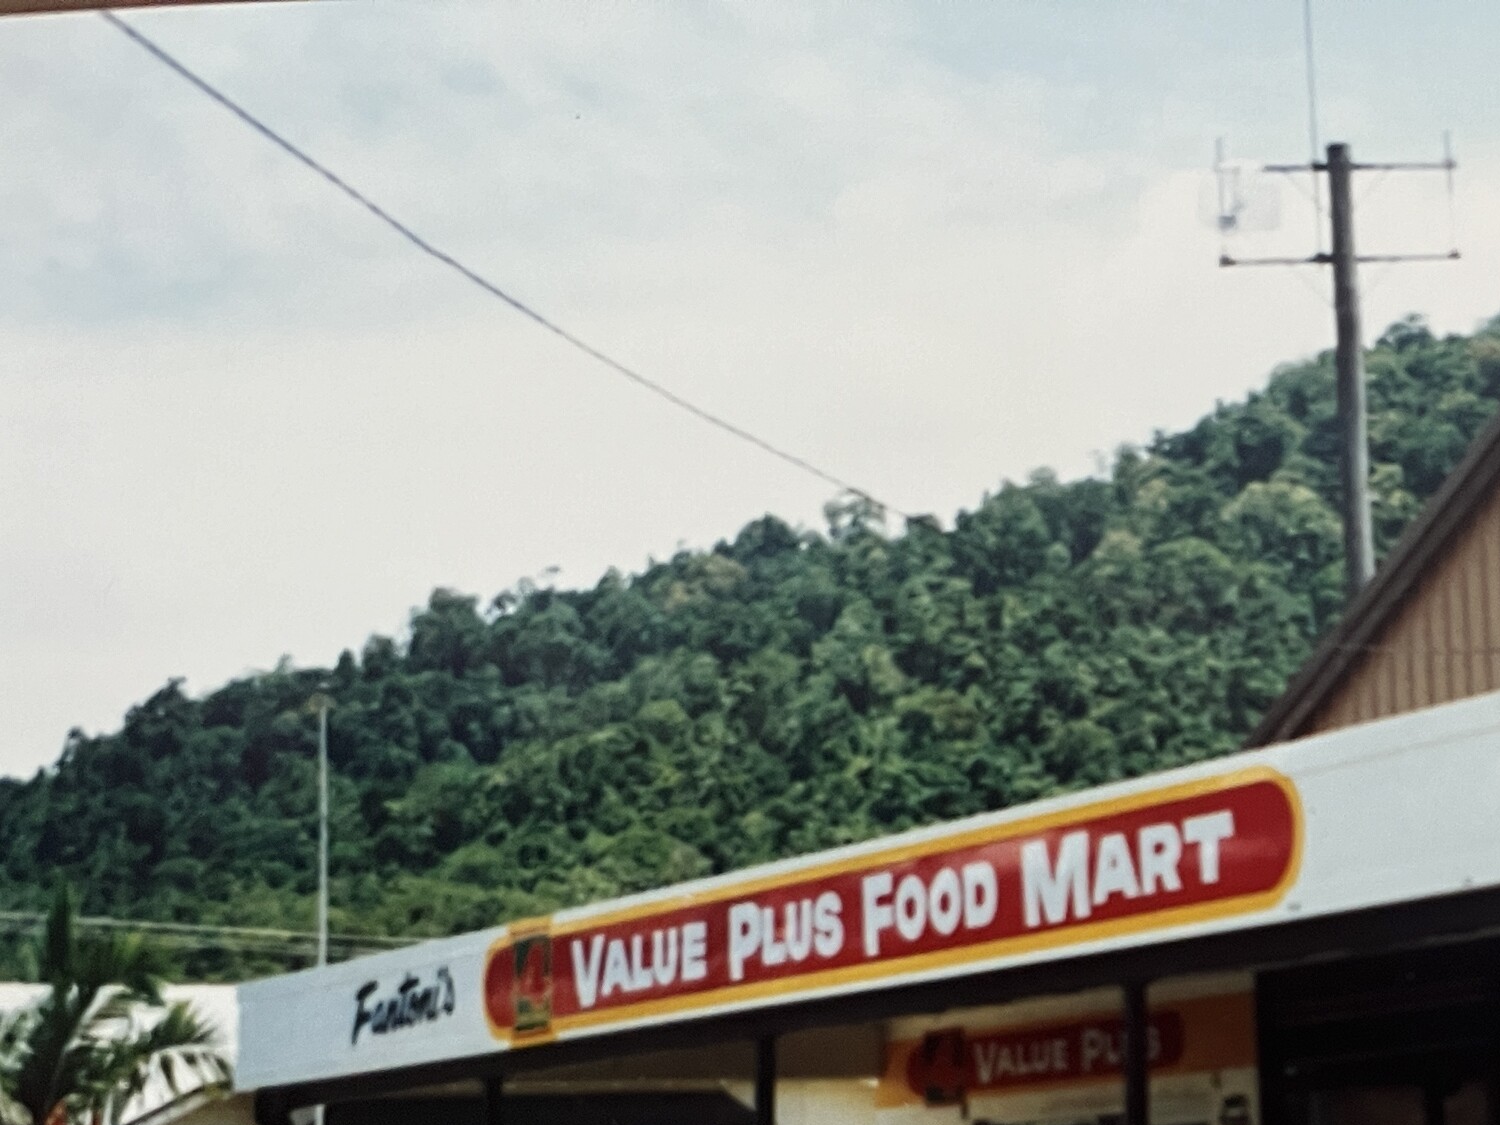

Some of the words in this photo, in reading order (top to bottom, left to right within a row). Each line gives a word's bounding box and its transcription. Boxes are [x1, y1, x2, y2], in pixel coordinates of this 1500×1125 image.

[571, 920, 708, 1009] VALUE
[727, 890, 843, 981] PLUS
[861, 860, 998, 957] FOOD
[1019, 808, 1237, 929] MART
[972, 1037, 1070, 1084] VALUE
